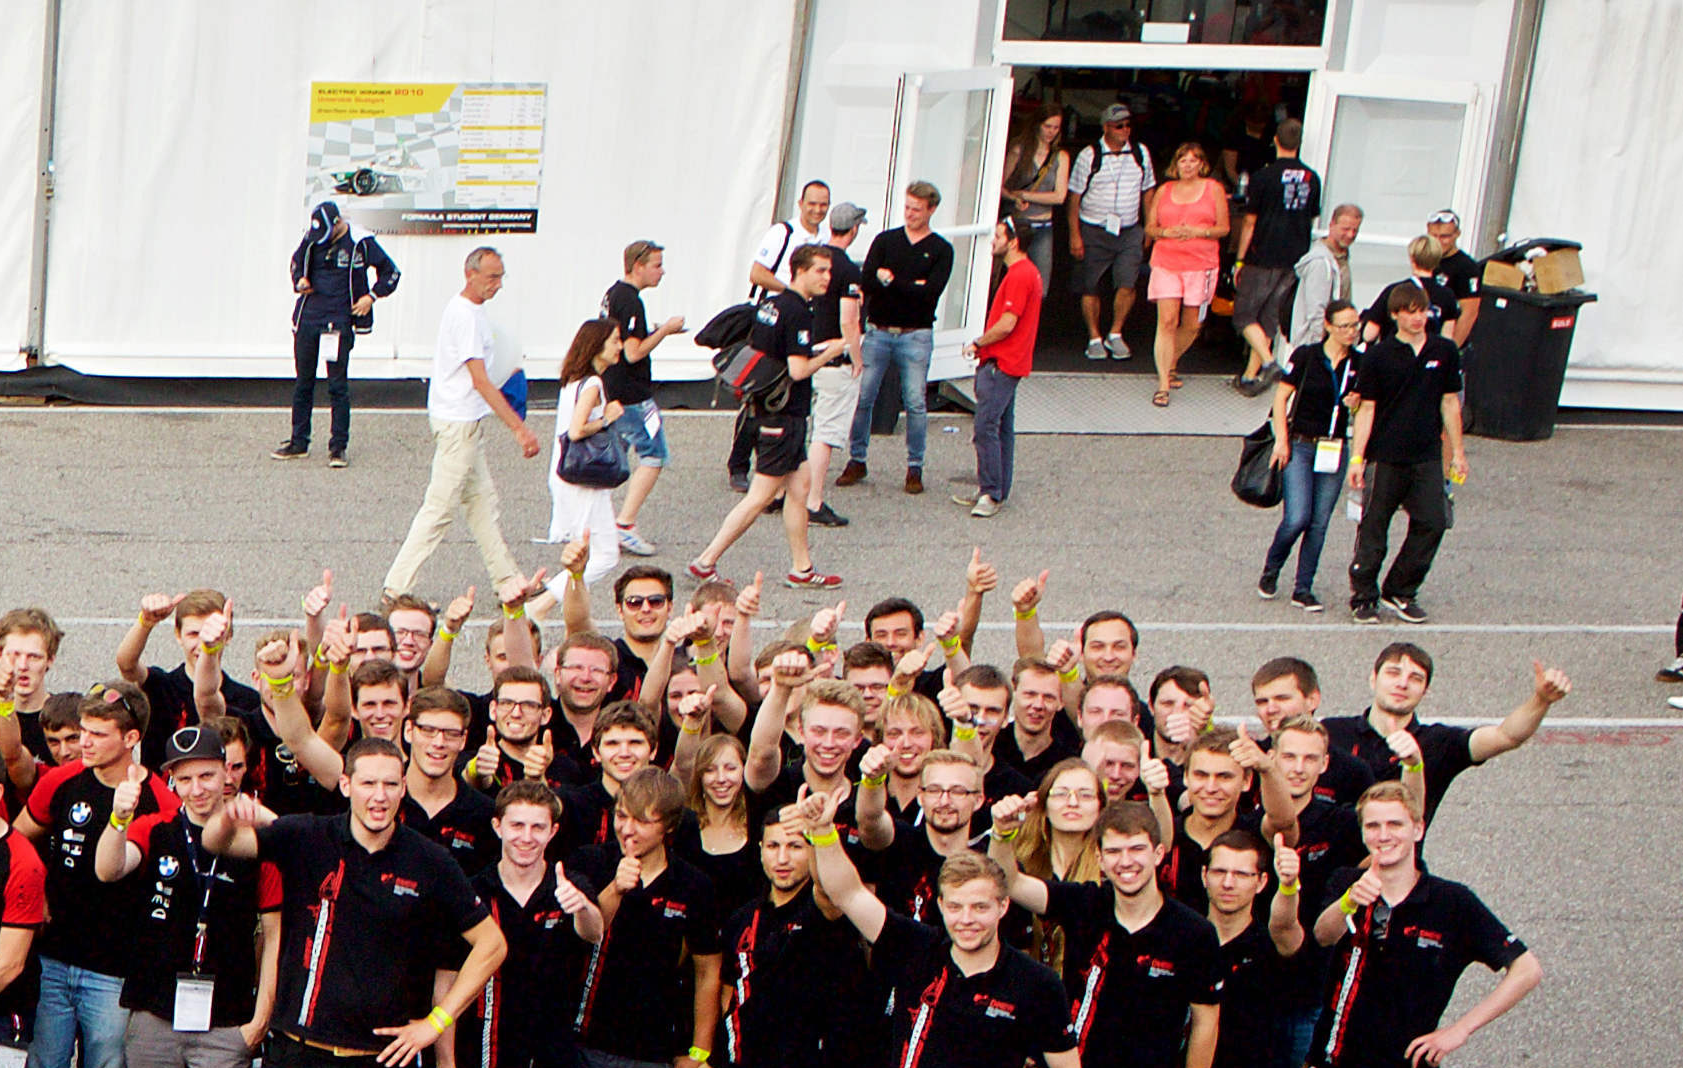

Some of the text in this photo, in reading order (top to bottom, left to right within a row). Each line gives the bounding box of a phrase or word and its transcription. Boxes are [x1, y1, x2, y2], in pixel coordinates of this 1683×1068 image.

[394, 88, 424, 96] 2010
[401, 213, 533, 221] FORMULA STUDENT GERMANY
